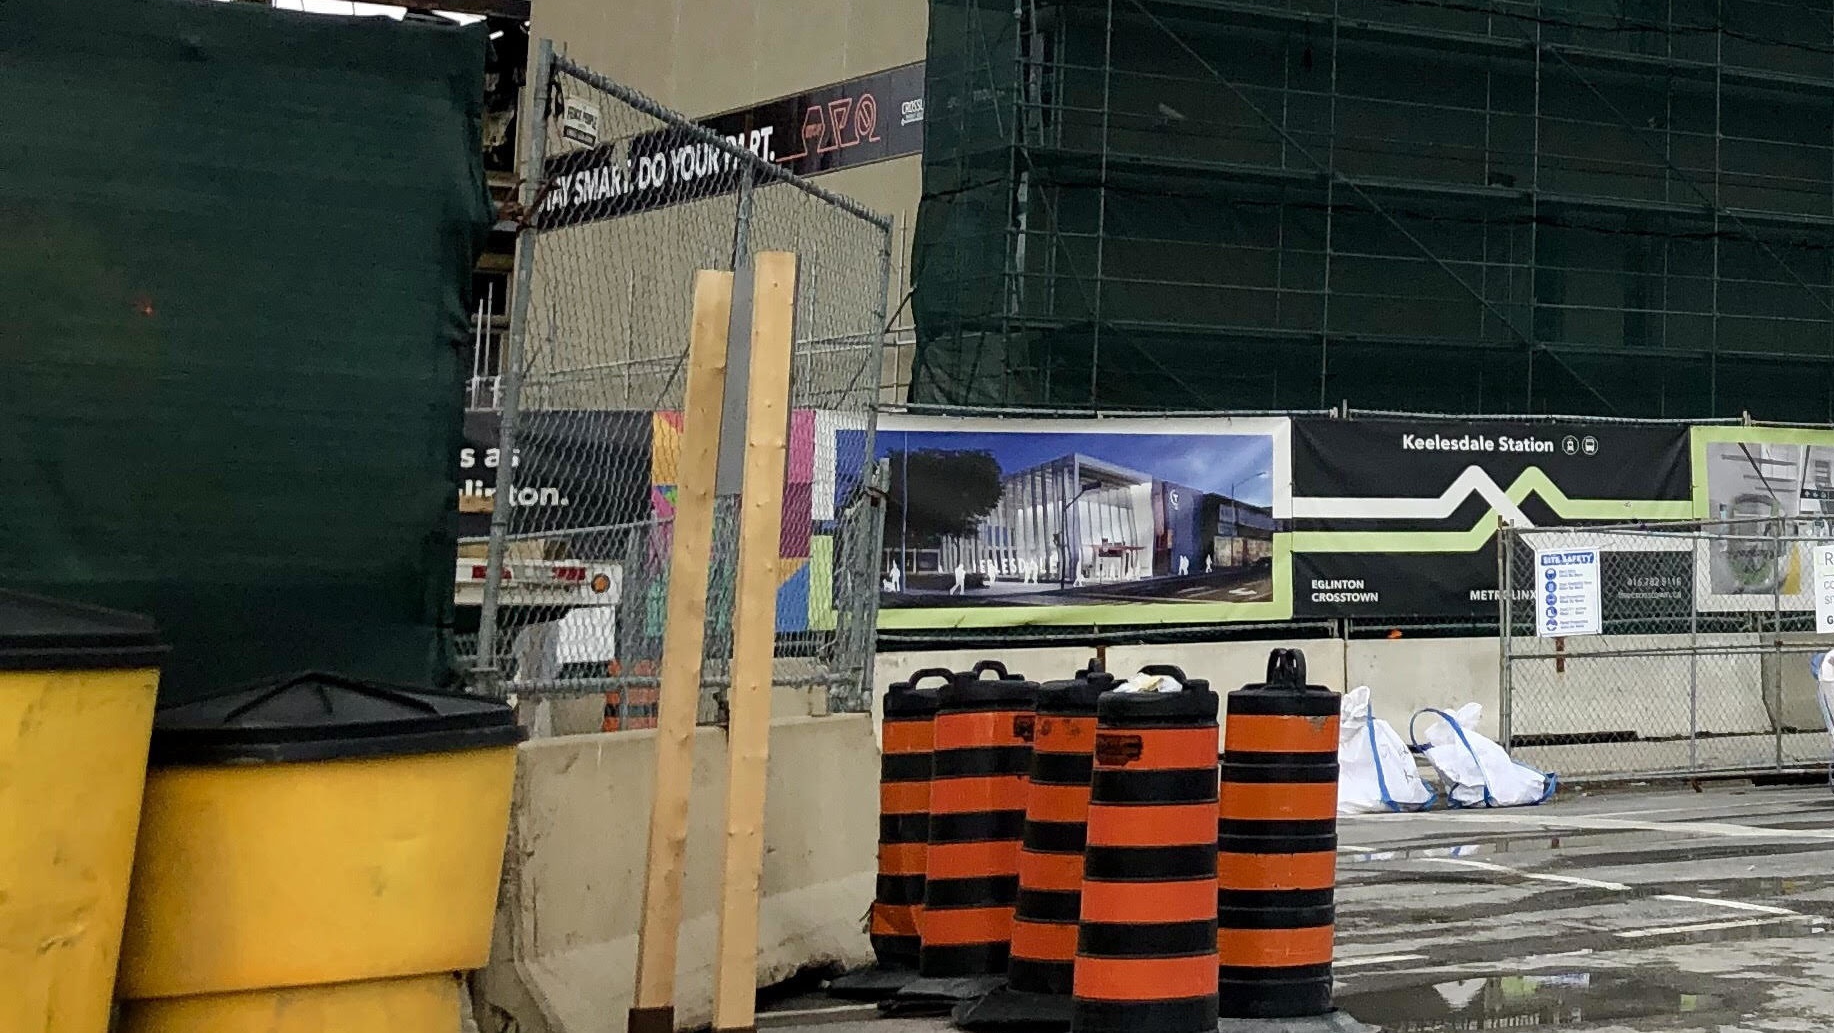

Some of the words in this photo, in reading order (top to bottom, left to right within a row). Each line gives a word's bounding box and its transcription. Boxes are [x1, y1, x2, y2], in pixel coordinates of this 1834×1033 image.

[638, 151, 667, 191] DO
[1402, 433, 1495, 452] Keelesdale
[1498, 436, 1554, 453] Station
[1311, 579, 1365, 590] EGLINTON
[1311, 592, 1379, 603] CROSSTOWN
[1469, 589, 1537, 601] METRLINX
